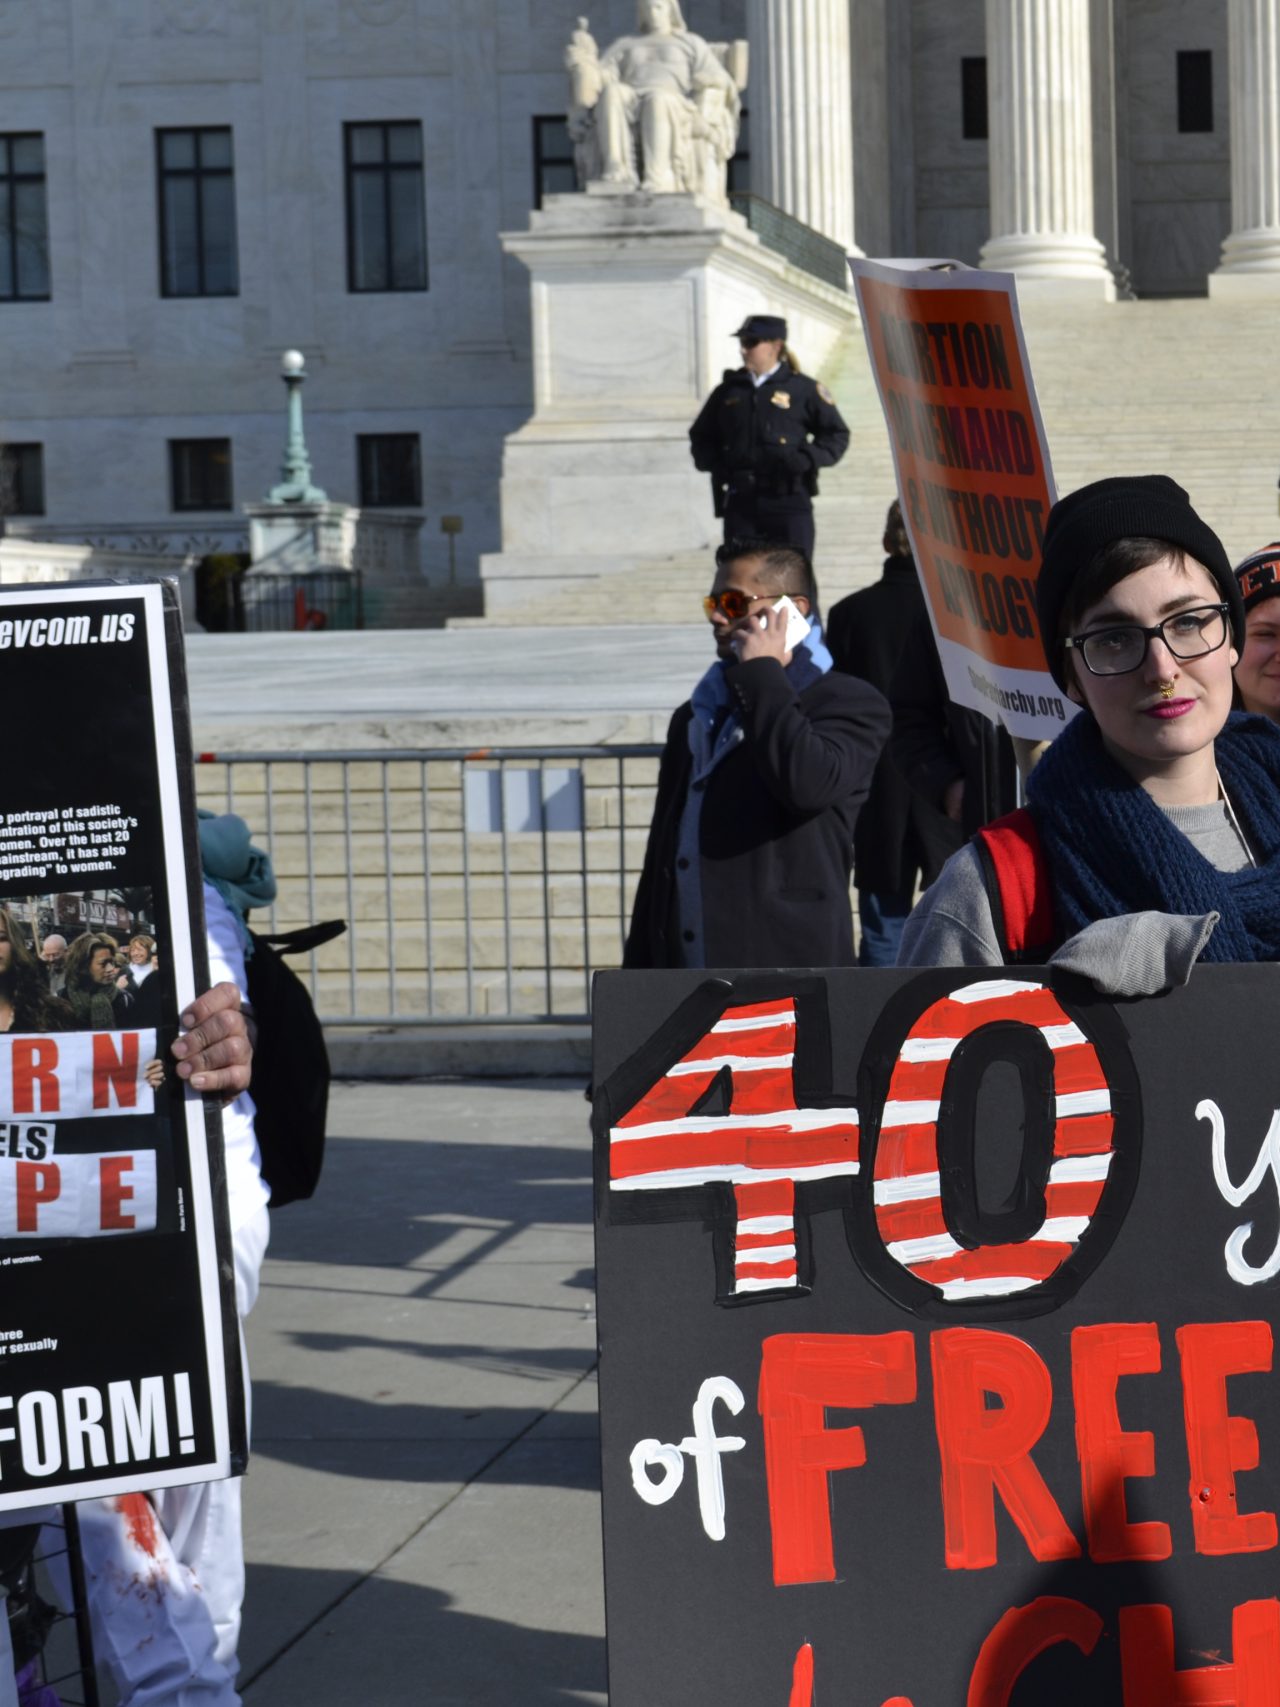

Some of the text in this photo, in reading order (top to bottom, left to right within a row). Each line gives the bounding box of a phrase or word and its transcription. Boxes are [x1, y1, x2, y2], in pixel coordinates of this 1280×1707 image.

[7, 808, 59, 825] portrayal
[61, 807, 74, 819] of
[75, 804, 121, 818] sadistic
[49, 822, 61, 834] of
[63, 820, 86, 832] this
[39, 836, 67, 848] Over
[69, 834, 88, 845] the
[91, 832, 112, 843] last
[115, 830, 130, 842] 20
[0, 845, 126, 865] ainstream, it has also
[55, 863, 68, 874] to
[70, 860, 117, 873] women.
[605, 975, 1120, 1303] 40
[9, 1337, 58, 1354] sexually
[629, 1375, 746, 1541] of
